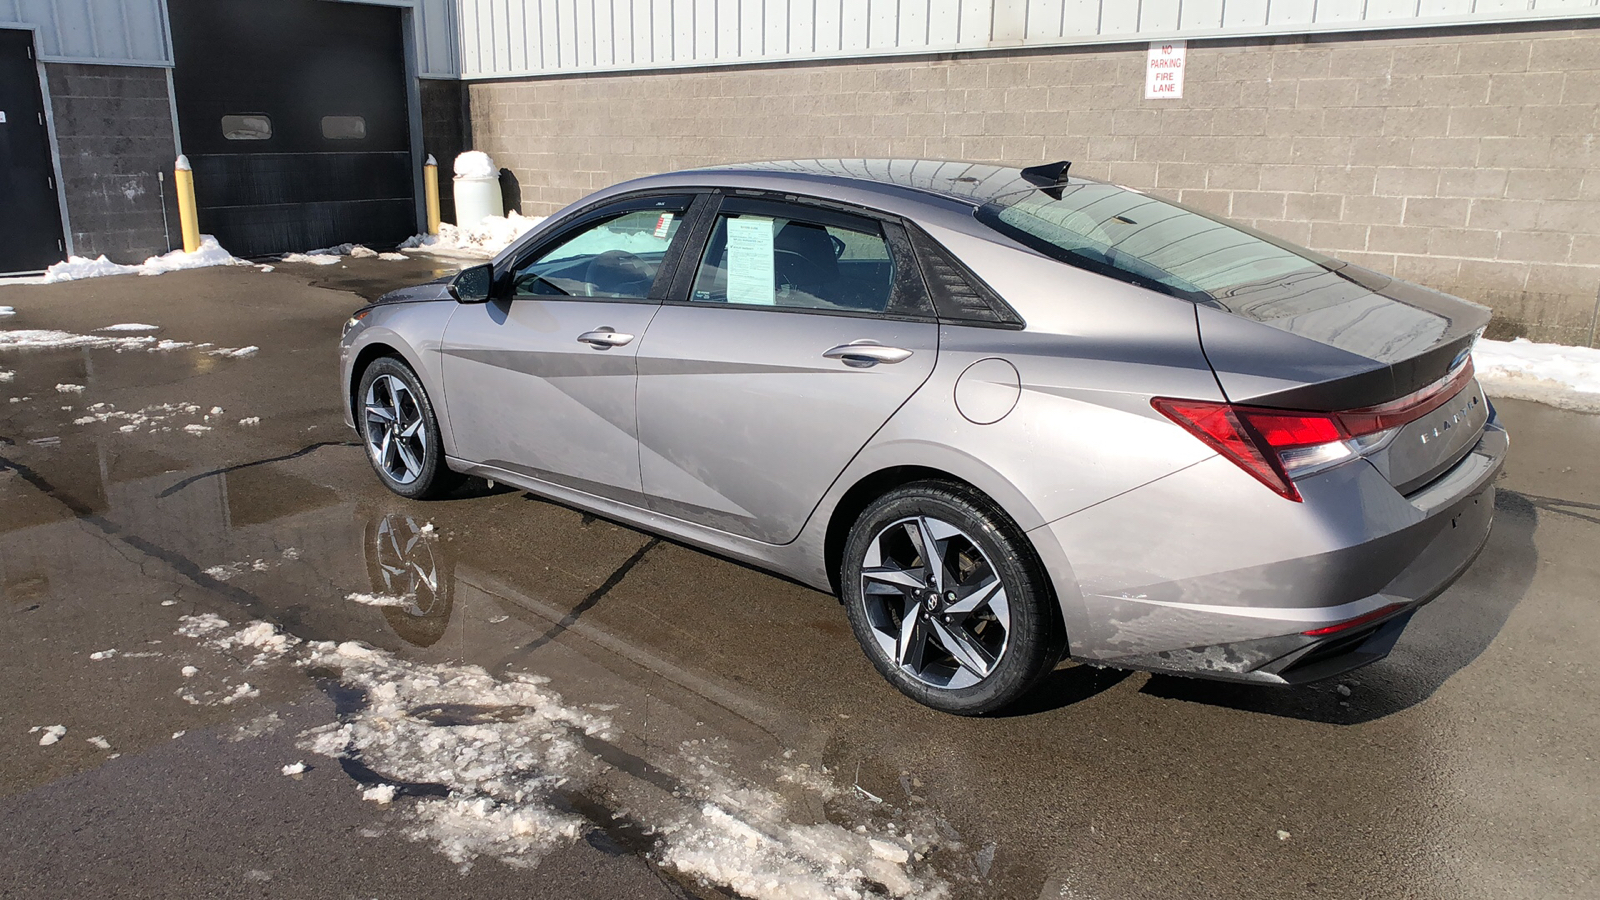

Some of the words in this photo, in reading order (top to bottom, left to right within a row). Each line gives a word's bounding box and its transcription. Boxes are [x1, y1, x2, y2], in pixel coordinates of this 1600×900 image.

[1162, 44, 1172, 54] NO
[1151, 58, 1181, 68] PARKING
[1156, 72, 1173, 80] FIRE
[1153, 83, 1175, 92] LANE
